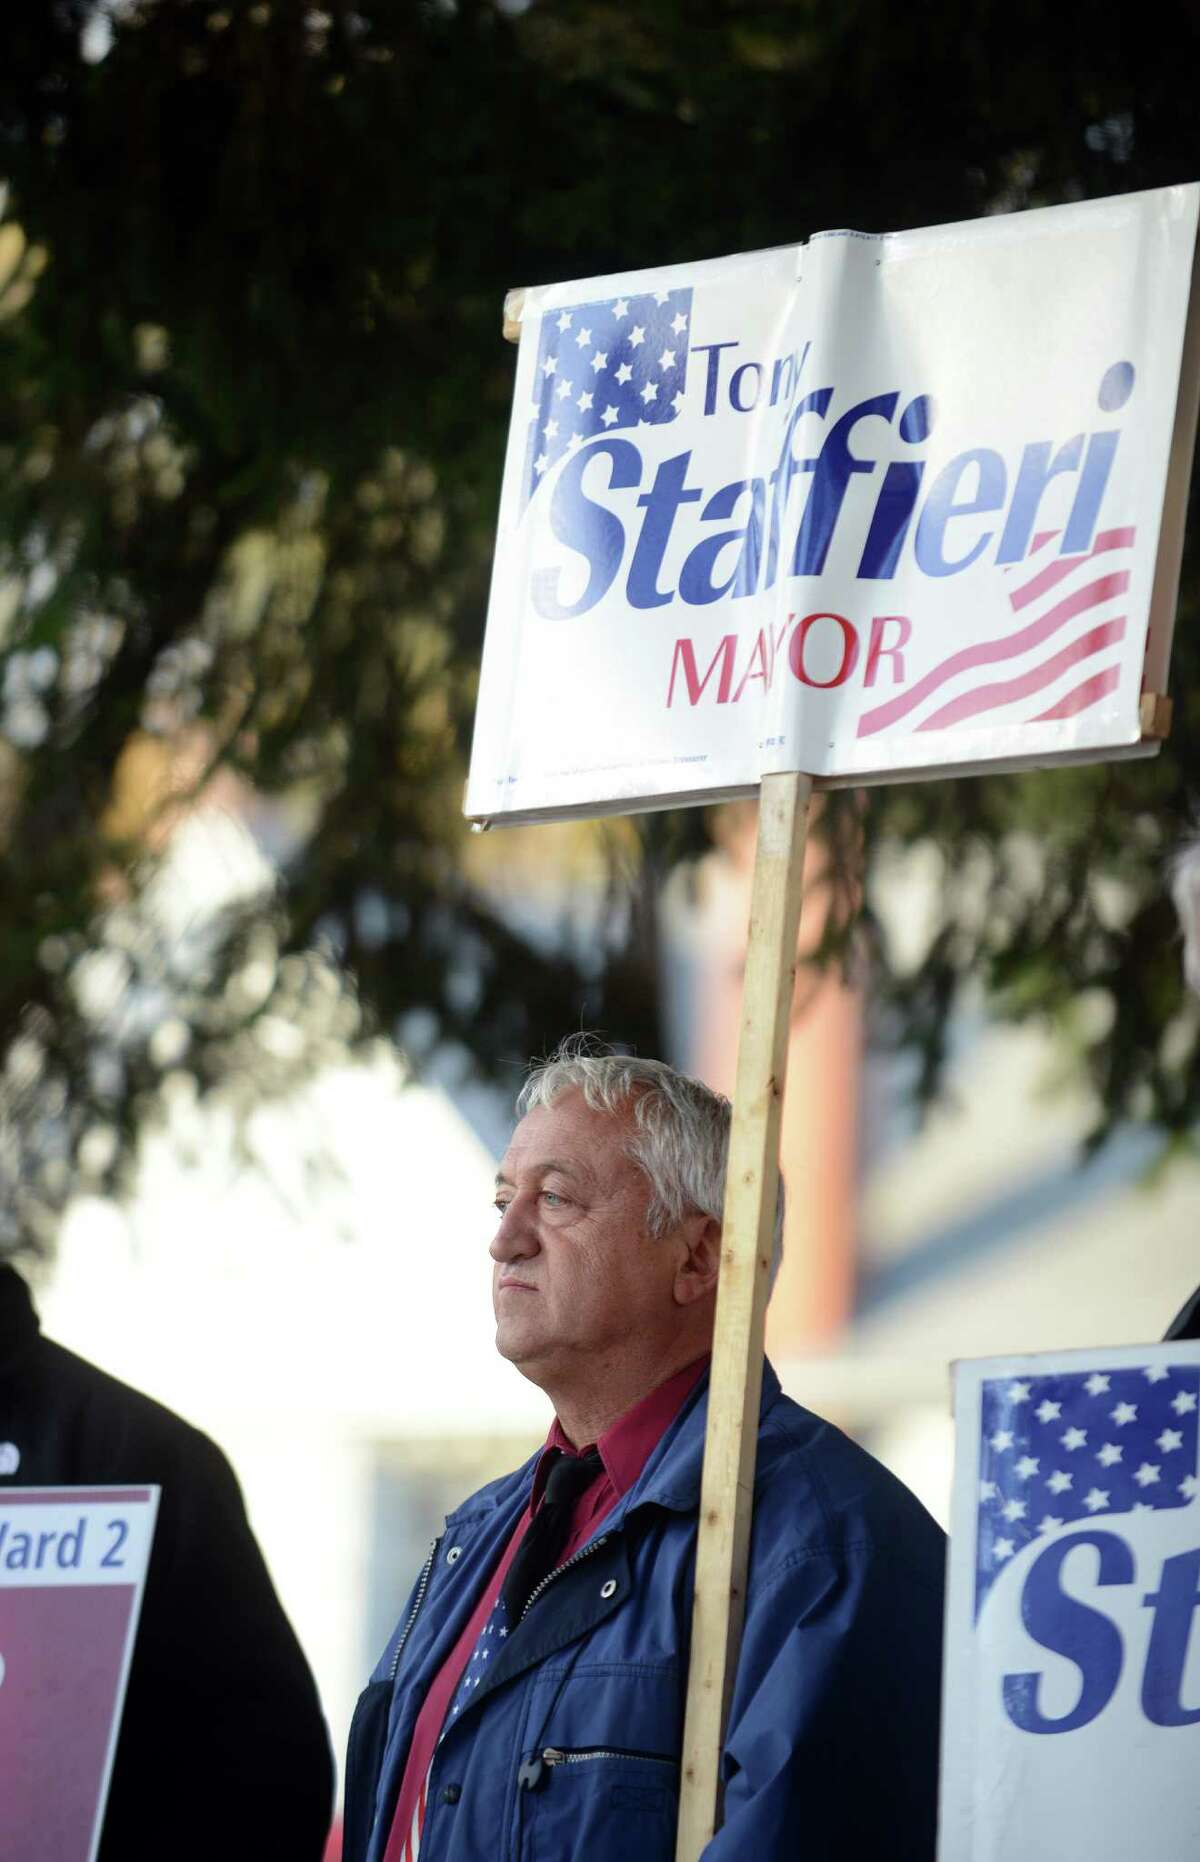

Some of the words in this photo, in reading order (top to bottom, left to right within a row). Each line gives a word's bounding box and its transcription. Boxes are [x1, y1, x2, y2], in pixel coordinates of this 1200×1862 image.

[690, 340, 812, 424] Tony
[530, 360, 1135, 621] Staffieri
[666, 612, 913, 709] MAYOR
[100, 1518, 129, 1569] 2
